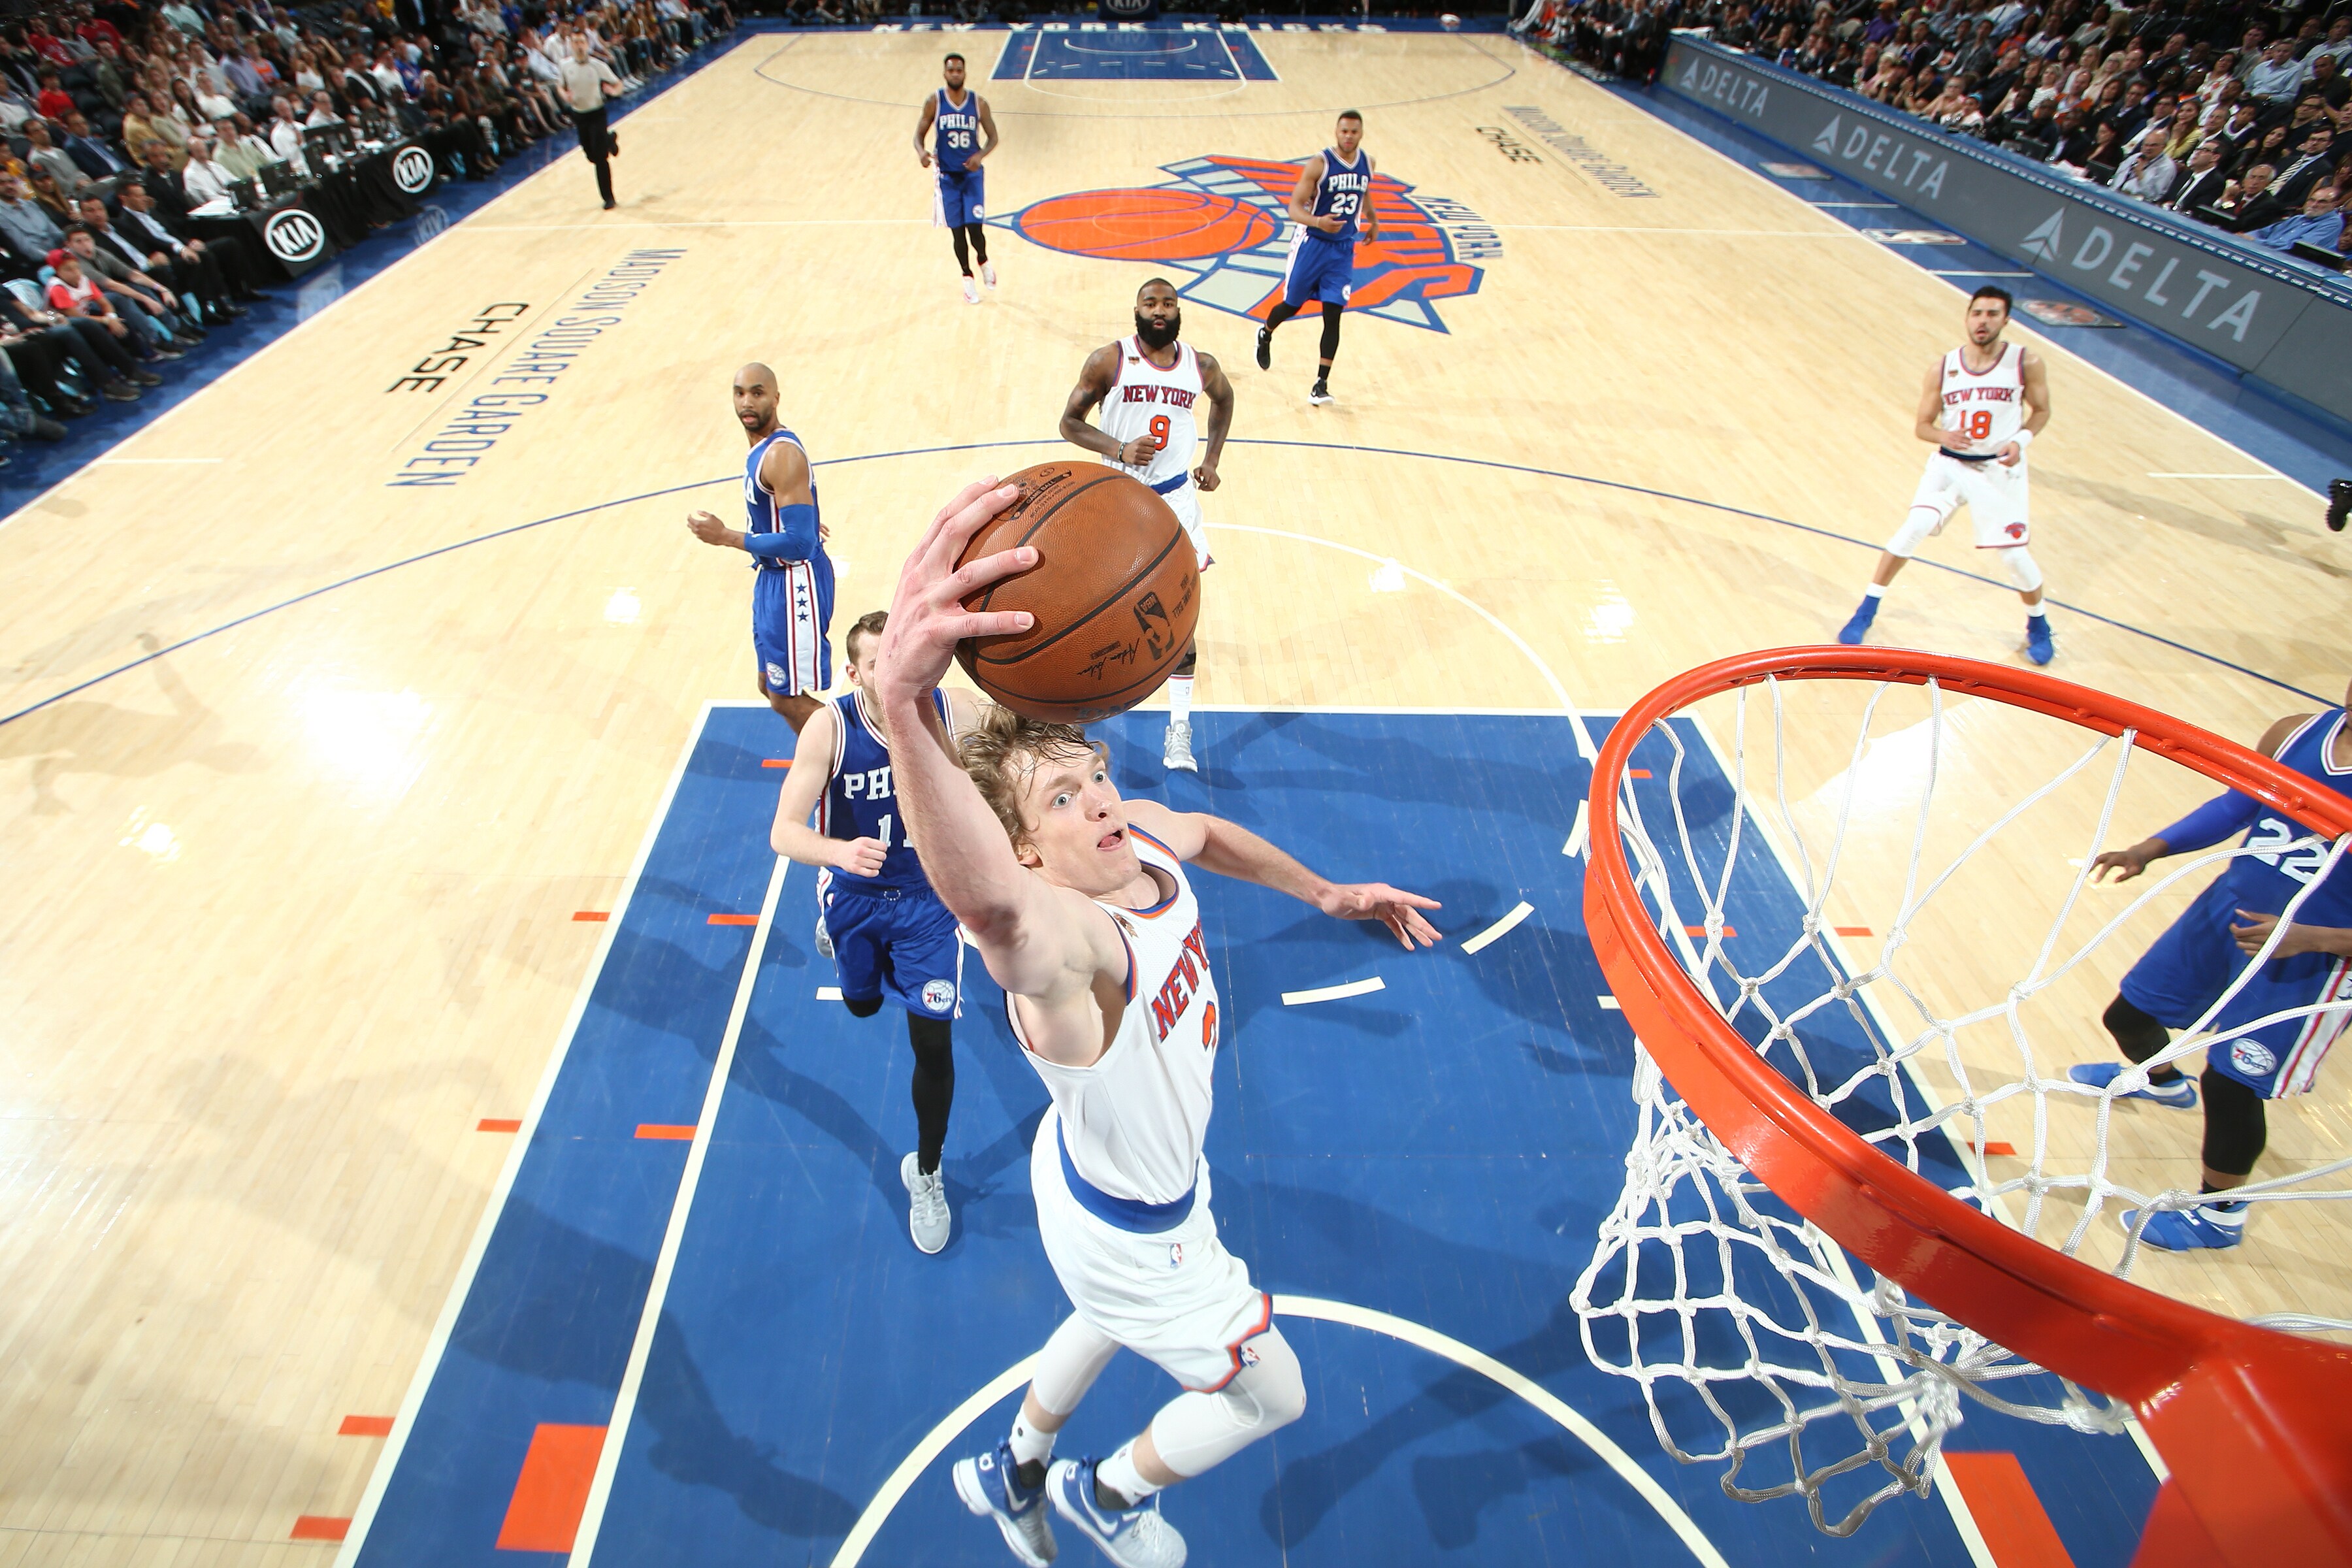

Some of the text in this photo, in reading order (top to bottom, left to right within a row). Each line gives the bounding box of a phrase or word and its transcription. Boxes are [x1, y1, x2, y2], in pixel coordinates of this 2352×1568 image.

[872, 22, 1387, 33] NEW YORK KNICKS
[1701, 65, 1769, 118] DELTA
[947, 131, 971, 149] 36
[397, 154, 429, 187] KIA
[1841, 125, 1949, 200] DELTA
[1330, 193, 1359, 215] 23
[270, 216, 318, 255] KIA
[2070, 225, 2262, 343] DELTA
[384, 301, 530, 393] CHASE
[384, 248, 688, 487] MADISON SQUARE GARDEN
[1122, 384, 1197, 410] NEW YORK
[1976, 387, 2014, 402] YORK
[1149, 414, 1171, 451] 9
[1959, 410, 1993, 440] 18
[1041, 480, 1056, 492] BALL
[1139, 593, 1157, 613] NBA
[2247, 817, 2330, 885] 22
[1151, 947, 1200, 1044] NEW
